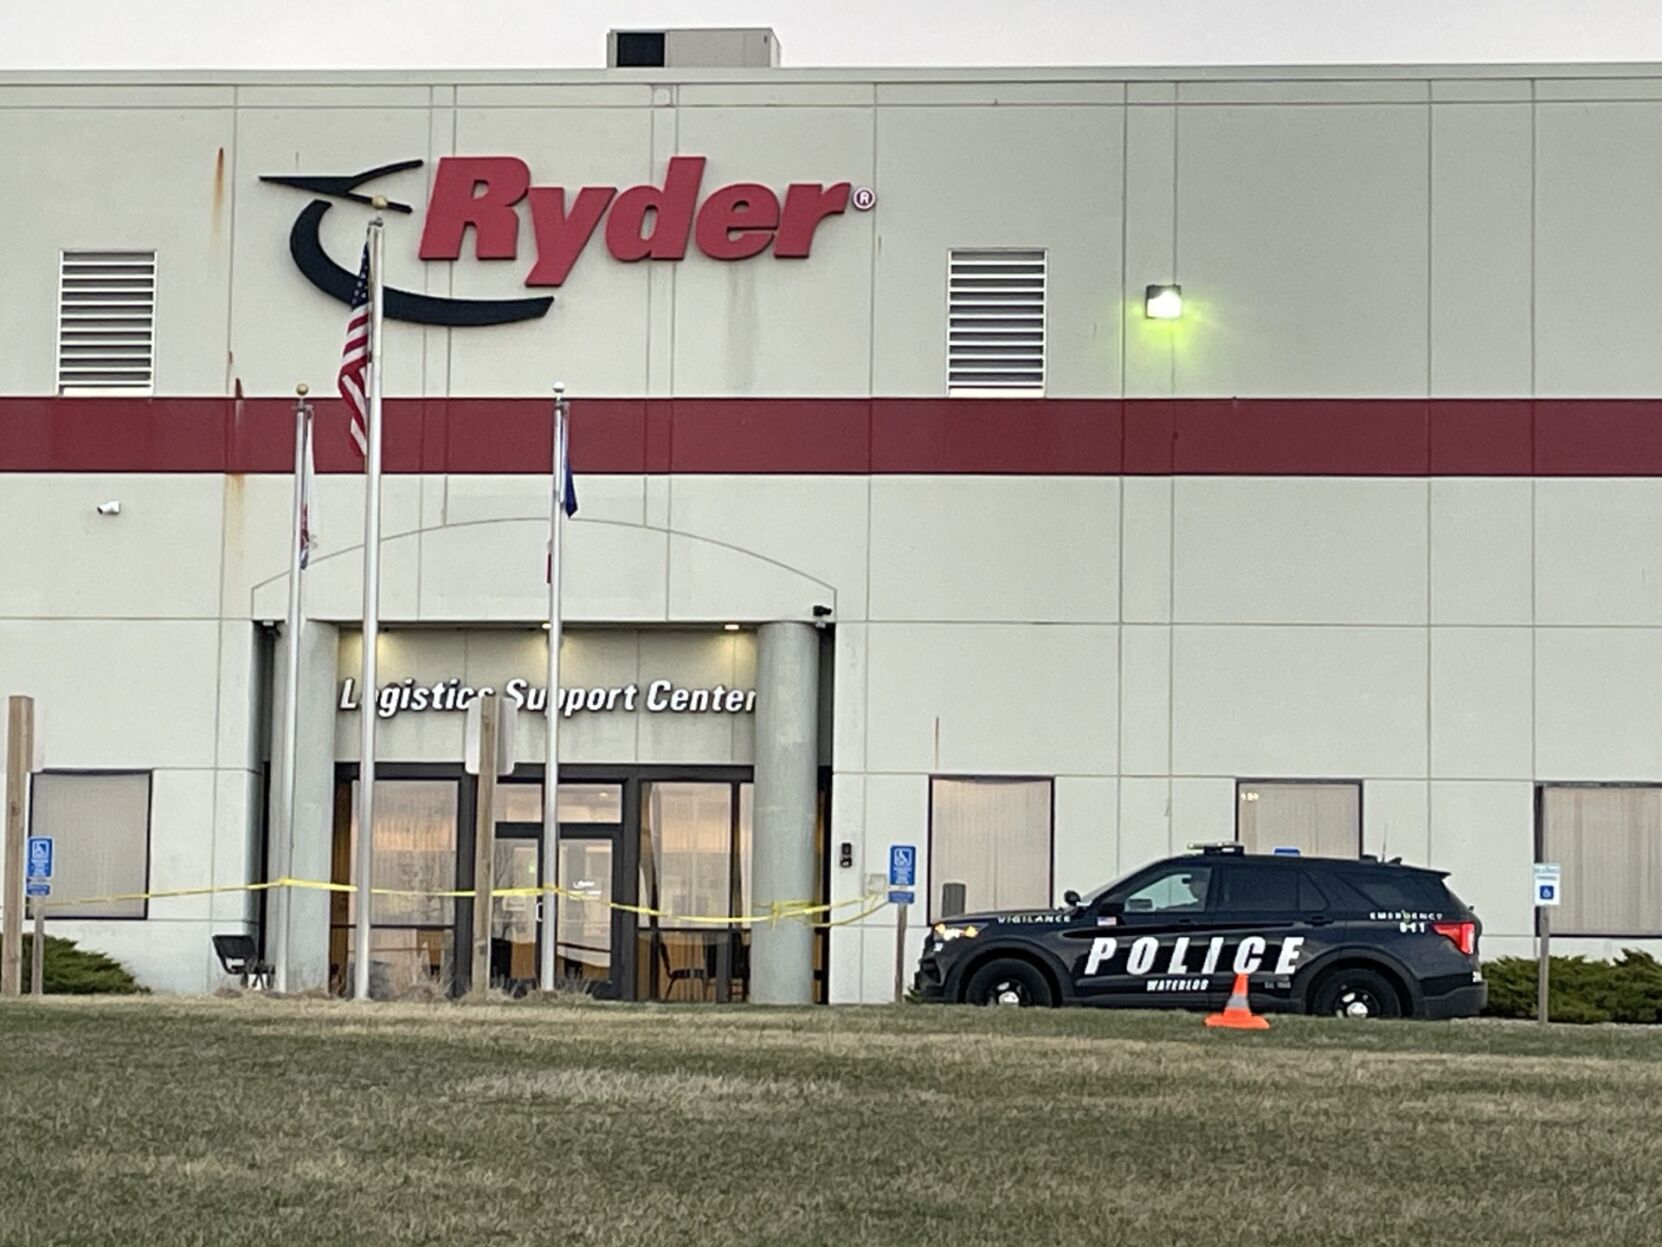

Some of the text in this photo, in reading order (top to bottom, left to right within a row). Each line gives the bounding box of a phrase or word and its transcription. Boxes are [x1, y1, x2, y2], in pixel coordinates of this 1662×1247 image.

[418, 155, 852, 288] Ryder
[339, 678, 496, 718] Lgistic
[1084, 936, 1305, 975] POLICE
[1146, 979, 1209, 991] WATERLOO
